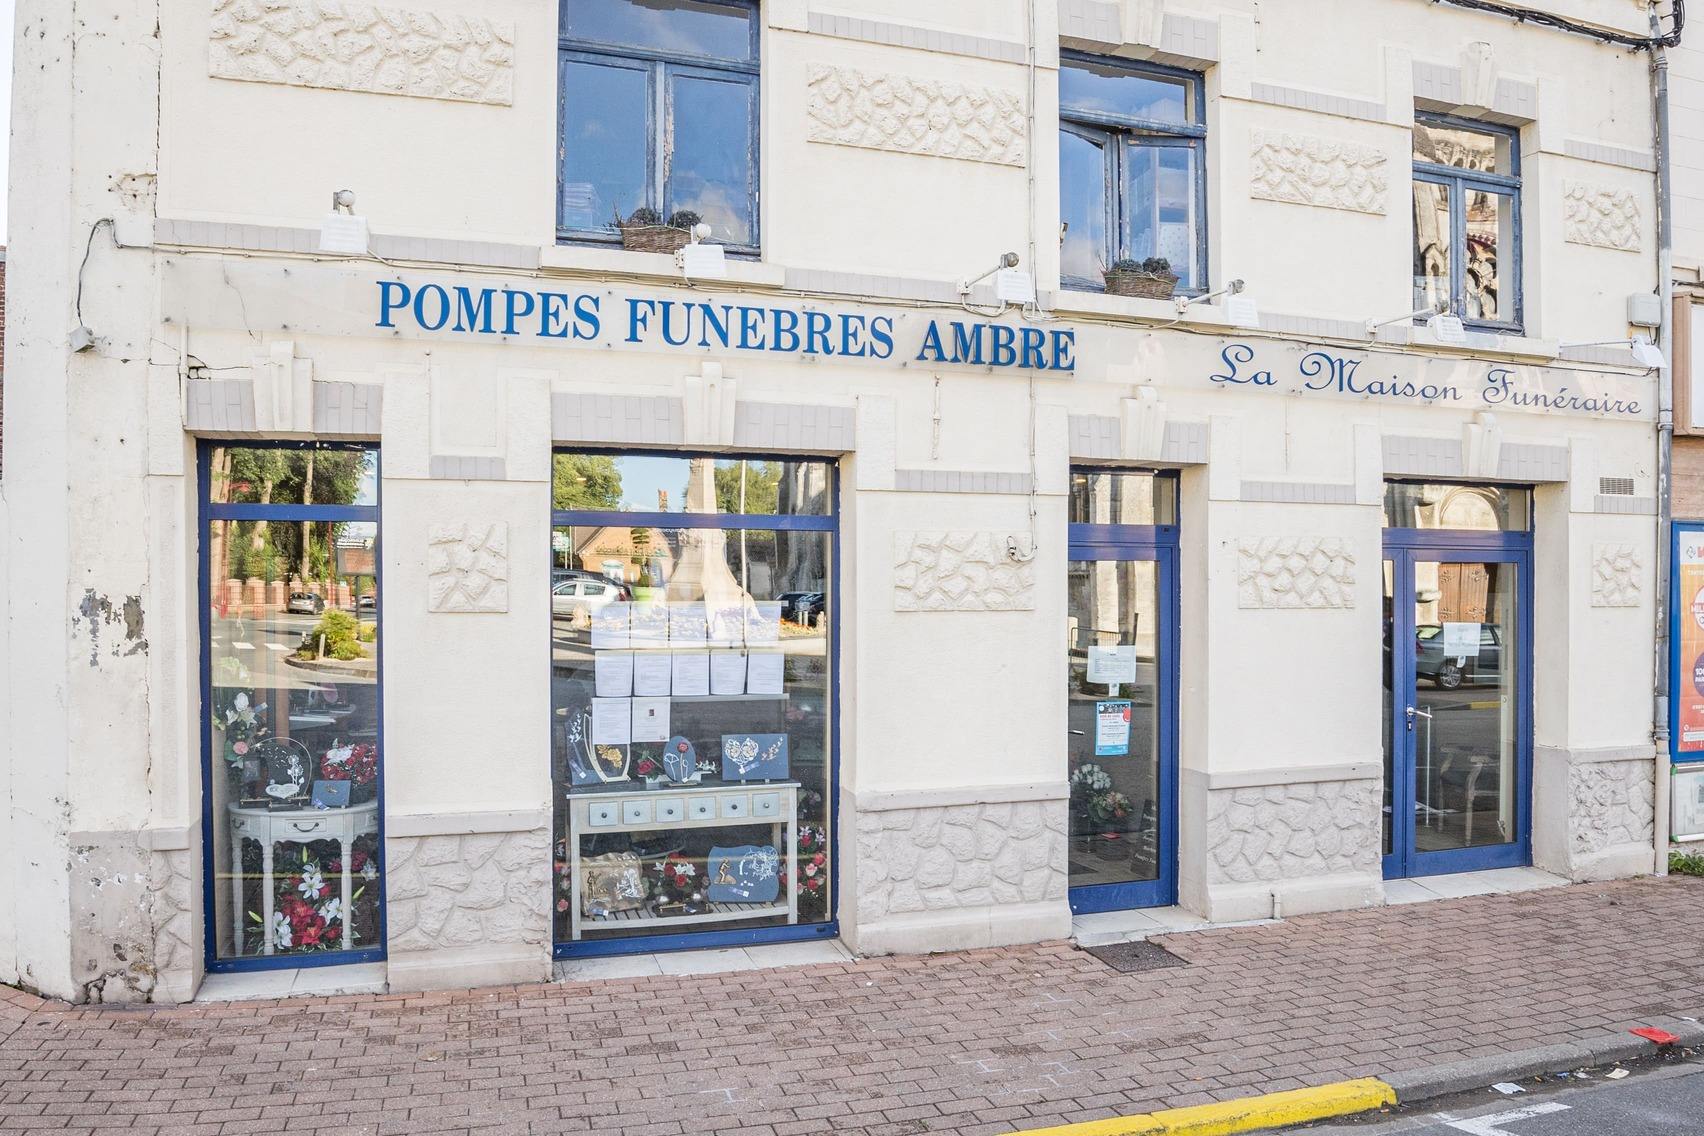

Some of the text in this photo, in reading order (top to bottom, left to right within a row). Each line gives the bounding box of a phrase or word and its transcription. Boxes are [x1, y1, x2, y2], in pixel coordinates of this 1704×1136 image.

[375, 280, 1076, 371] POMPES FUNEBRES AMBRE
[1209, 344, 1642, 414] La Maison Funéraire
